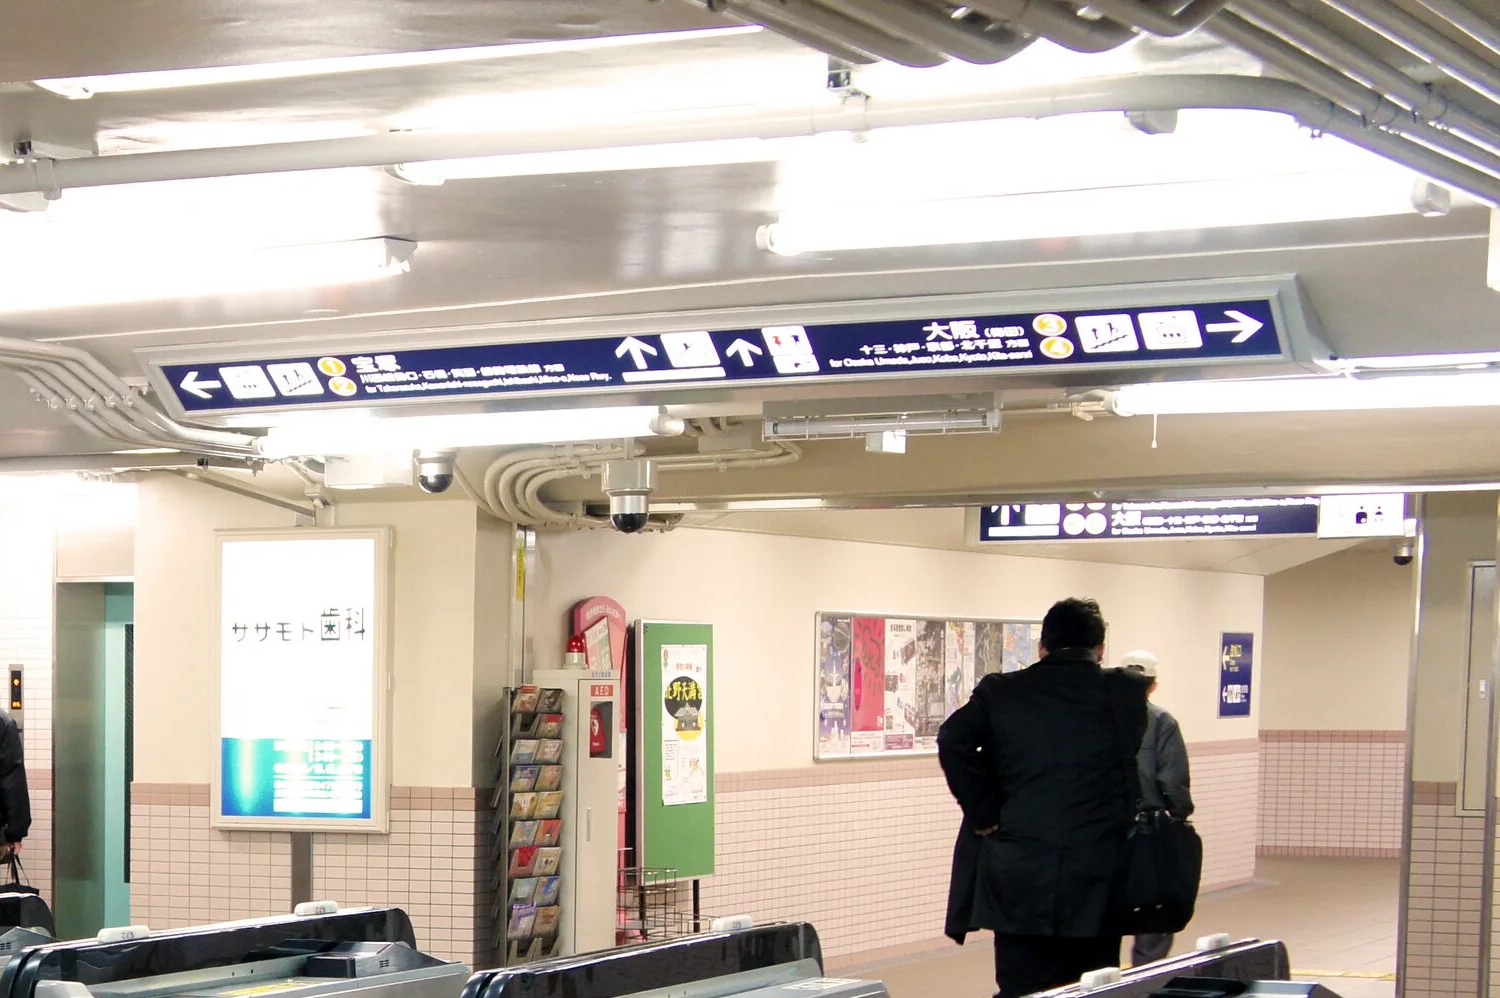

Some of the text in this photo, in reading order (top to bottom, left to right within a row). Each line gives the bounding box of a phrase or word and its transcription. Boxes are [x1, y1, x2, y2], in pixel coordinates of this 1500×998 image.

[232, 607, 366, 641] ササモト歯科
[594, 686, 610, 696] AED
